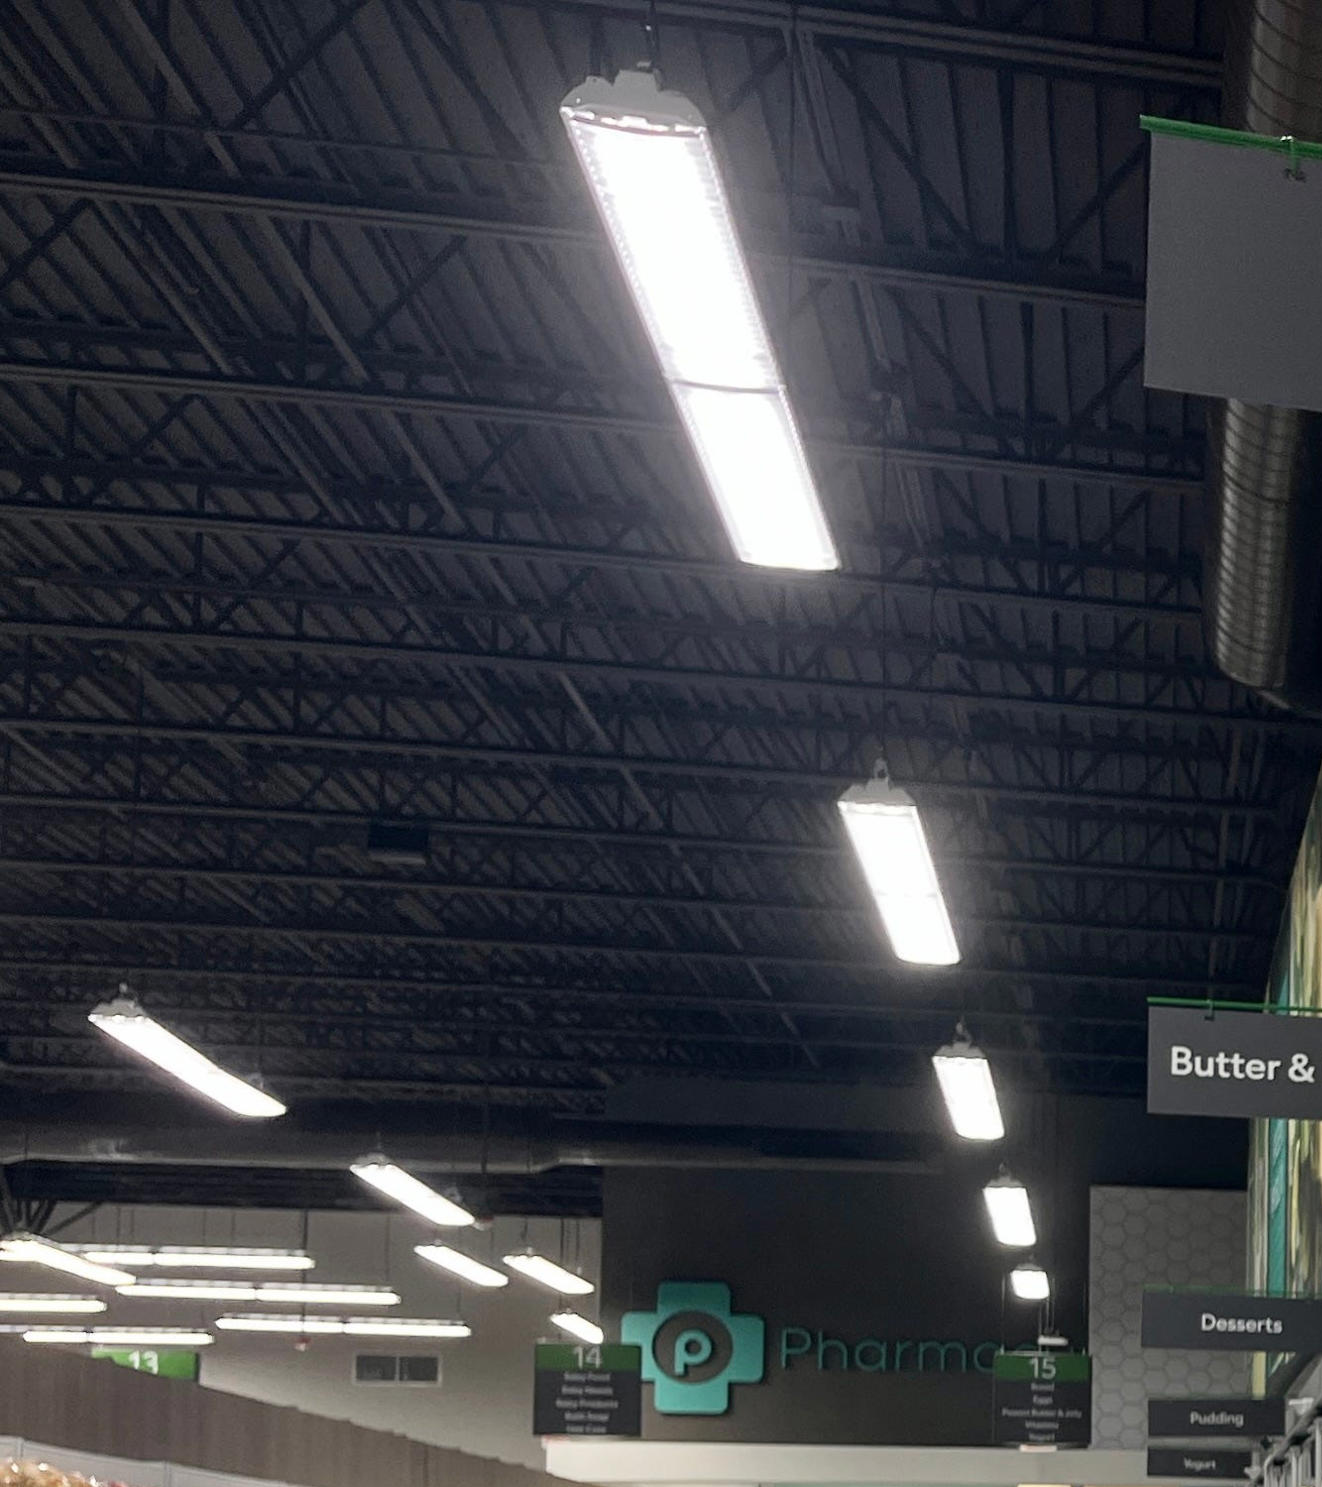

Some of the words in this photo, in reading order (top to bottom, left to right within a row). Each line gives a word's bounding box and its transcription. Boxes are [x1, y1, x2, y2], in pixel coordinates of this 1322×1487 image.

[1170, 1045, 1281, 1081] Butter
[1288, 1053, 1315, 1084] &
[1201, 1312, 1284, 1334] Desserts
[573, 1345, 602, 1369] 14
[780, 1327, 1035, 1372] Pharma
[1029, 1357, 1056, 1379] 15
[1190, 1411, 1244, 1428] Pudding
